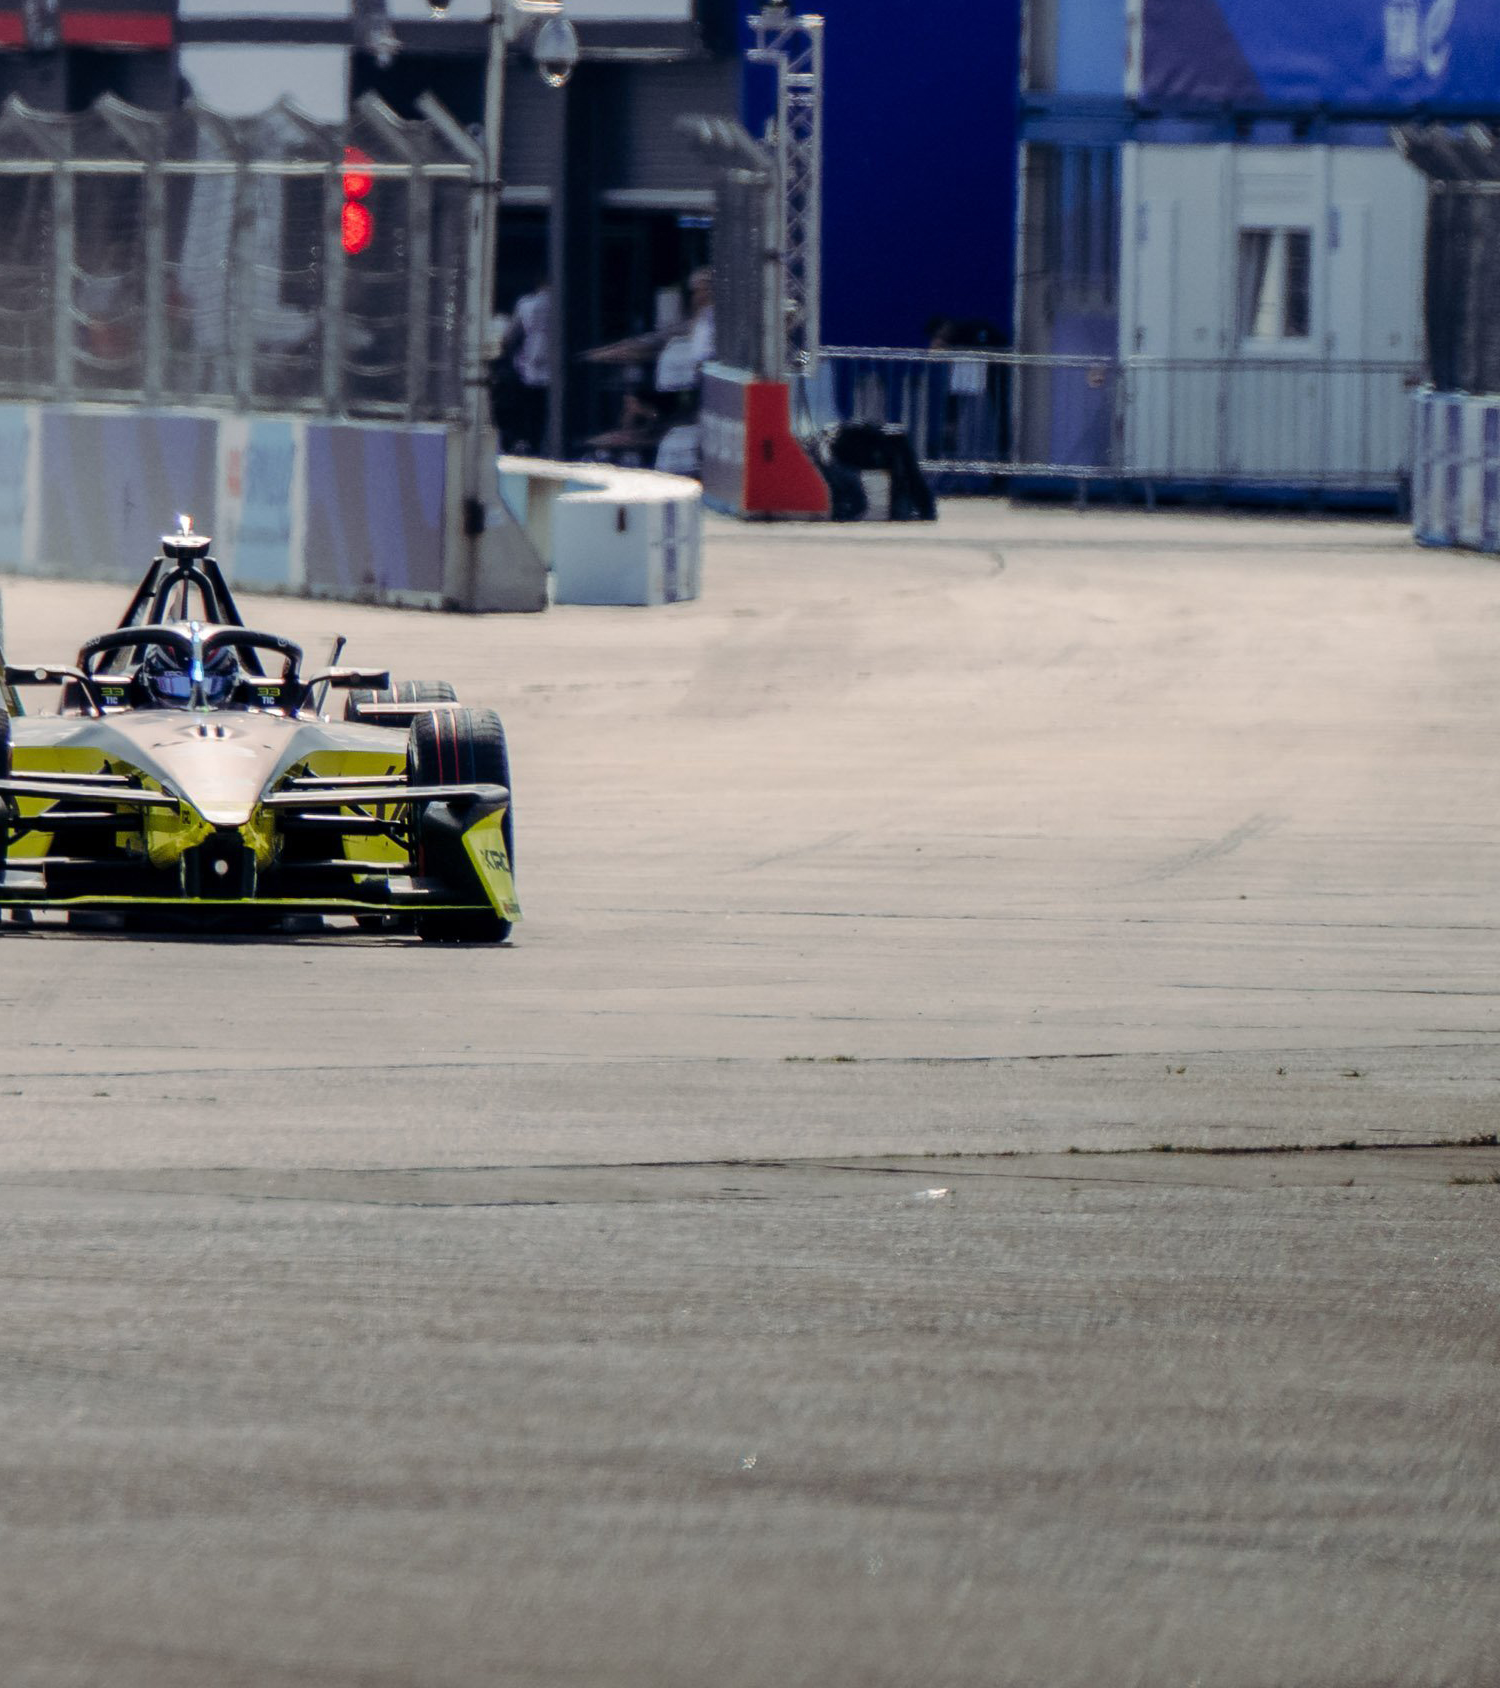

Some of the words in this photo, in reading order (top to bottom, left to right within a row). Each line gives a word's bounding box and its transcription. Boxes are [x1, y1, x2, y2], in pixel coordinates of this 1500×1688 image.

[101, 687, 125, 697] 33
[257, 687, 281, 697] 33
[106, 696, 119, 705] TIC
[262, 696, 275, 705] TIC
